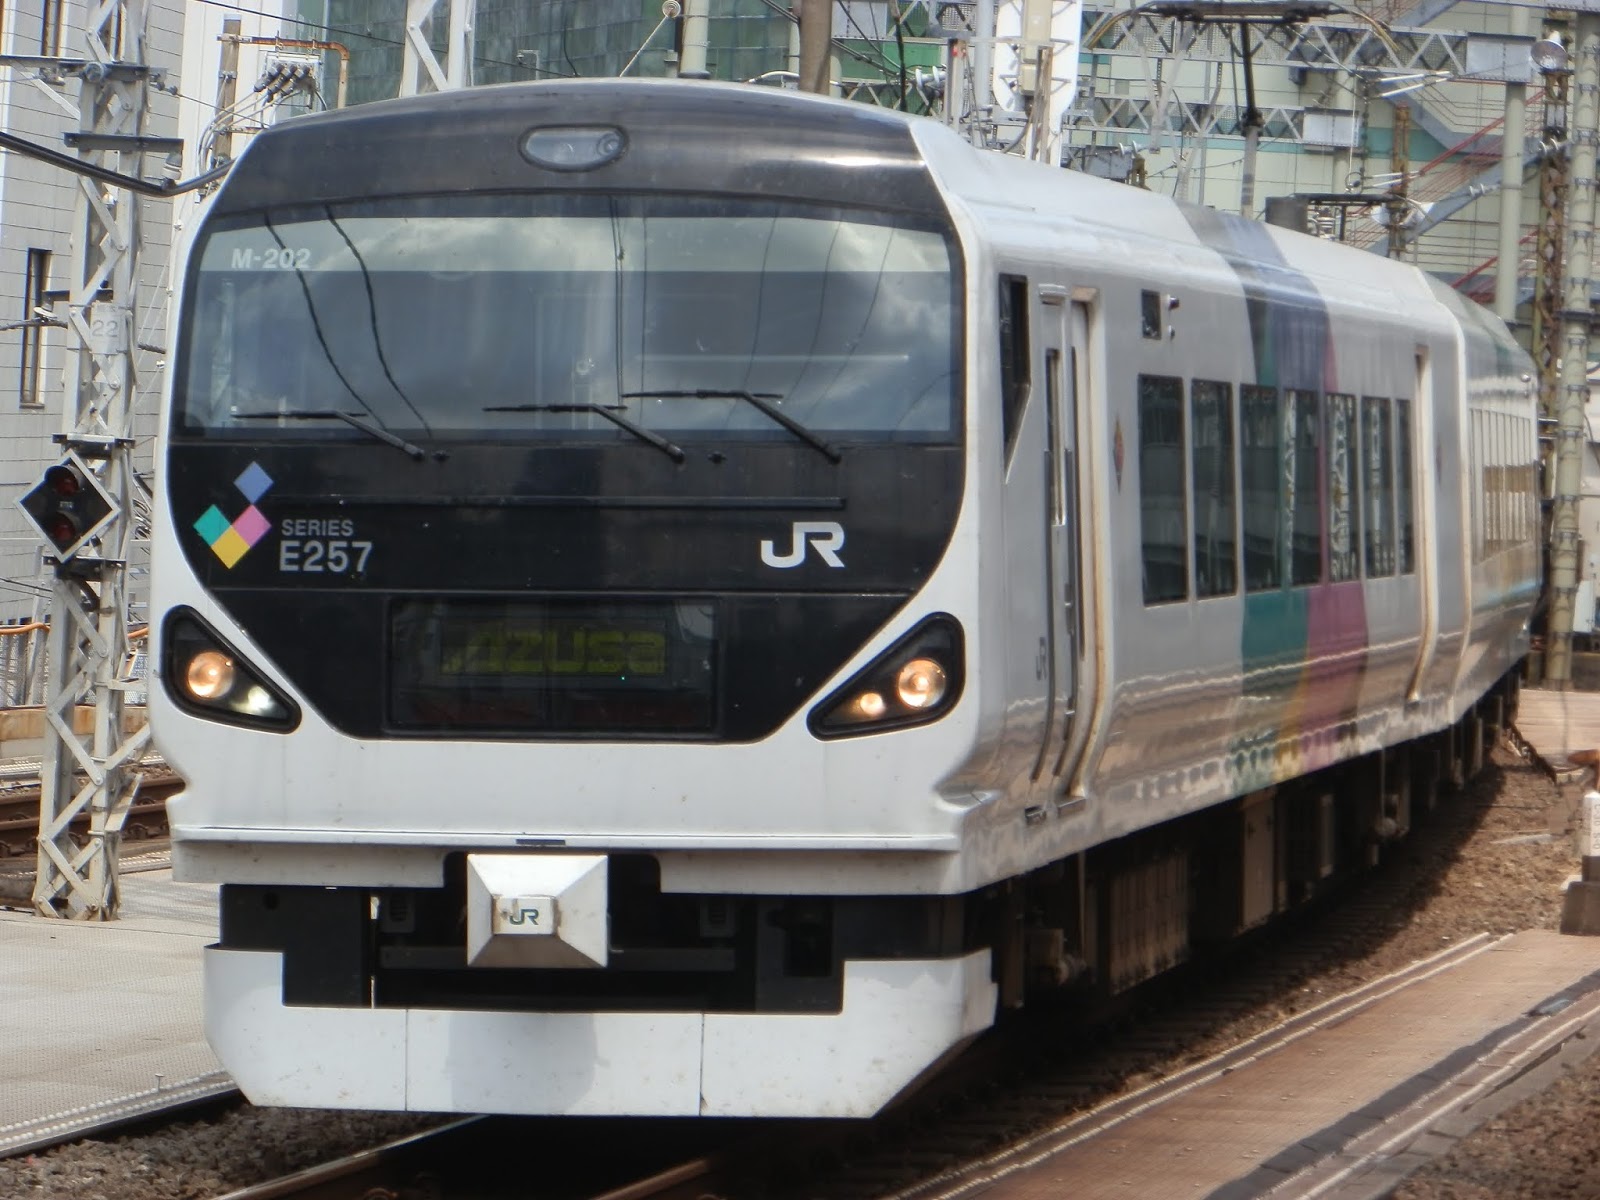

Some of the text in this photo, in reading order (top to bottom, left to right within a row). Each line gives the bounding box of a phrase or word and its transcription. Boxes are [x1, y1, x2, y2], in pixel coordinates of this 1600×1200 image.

[231, 248, 311, 269] M-202
[92, 320, 118, 337] 22
[281, 519, 354, 536] SERIES
[761, 521, 846, 568] JR
[280, 540, 372, 572] E257
[509, 908, 539, 926] JR
